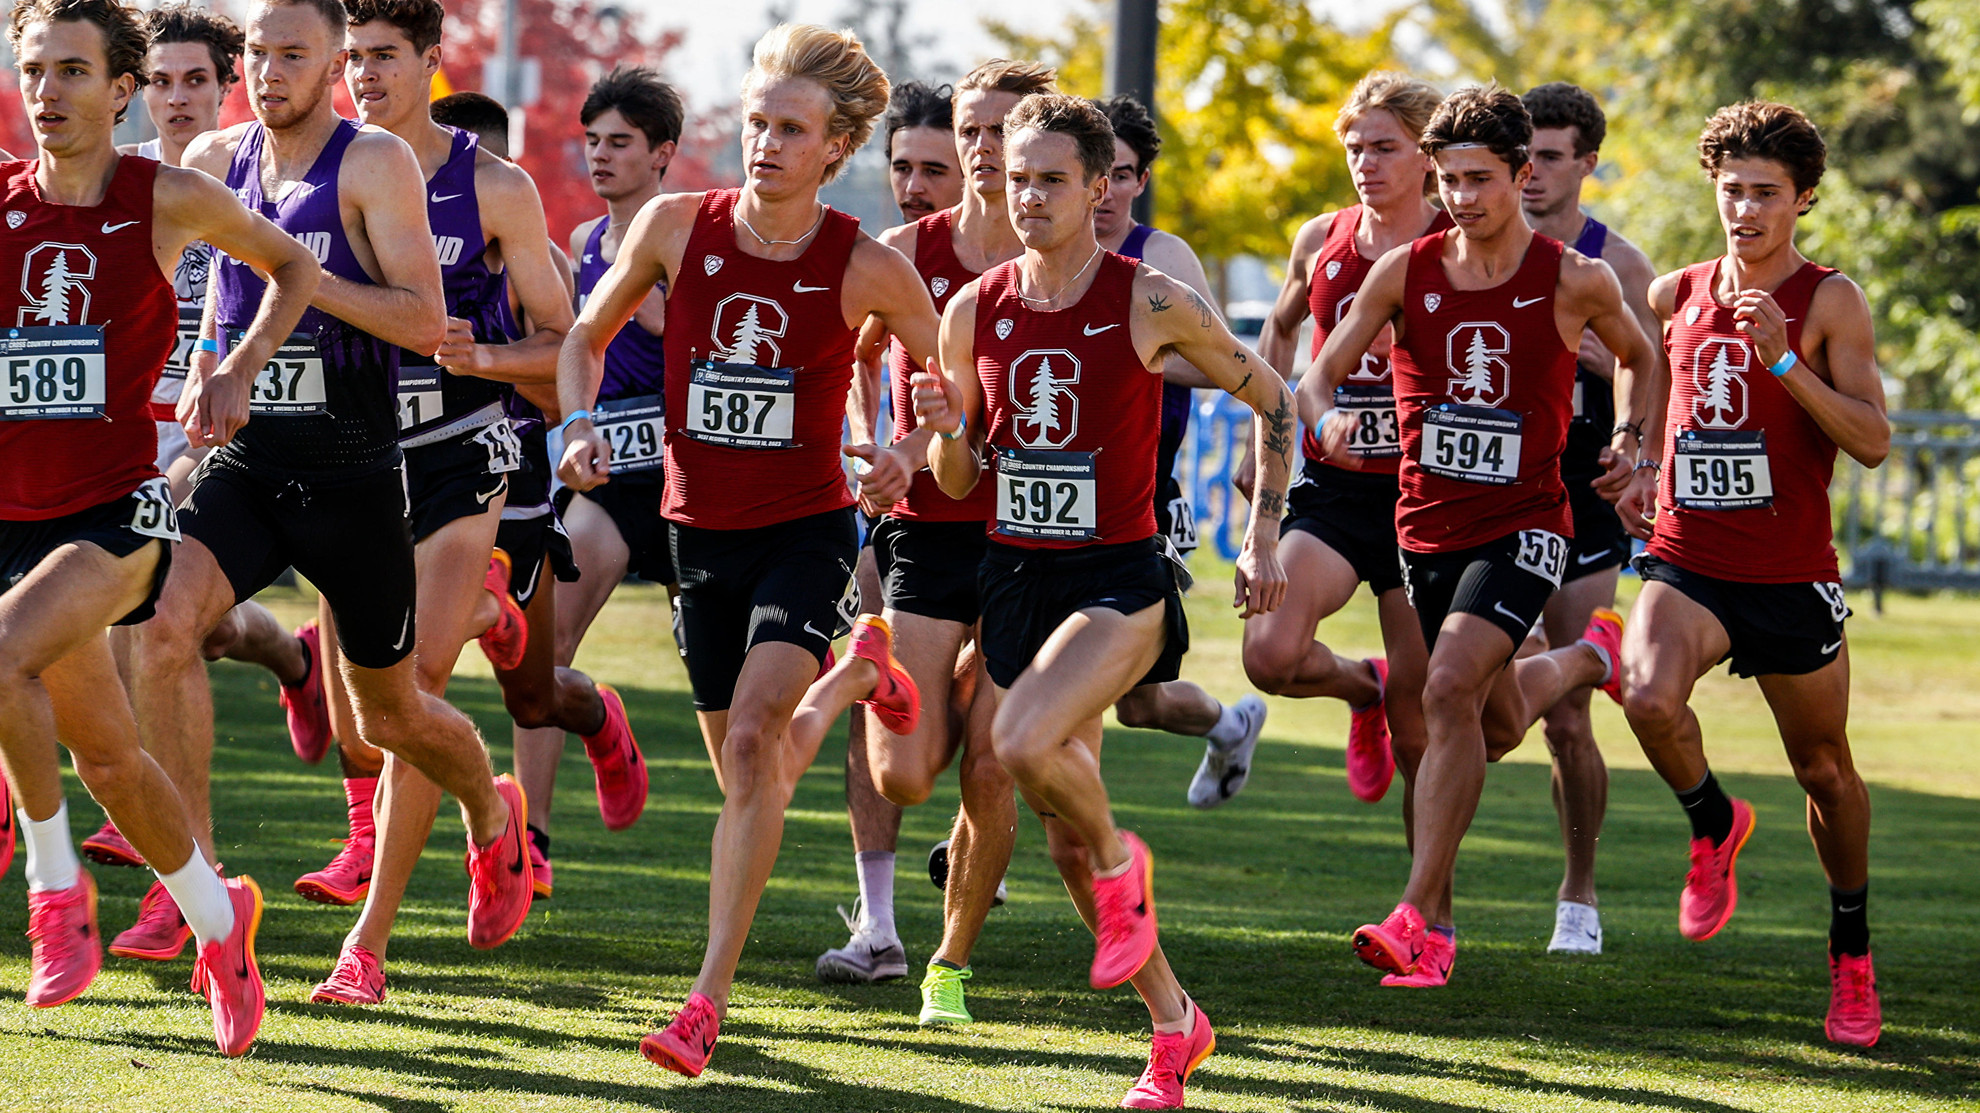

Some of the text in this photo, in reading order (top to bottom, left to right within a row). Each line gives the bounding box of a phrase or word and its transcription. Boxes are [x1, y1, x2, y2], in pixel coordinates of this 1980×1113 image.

[9, 357, 85, 403] 589
[398, 378, 436, 386] HAMPIONSHIPS
[745, 377, 789, 386] CHAMPIONSHIPS
[703, 390, 776, 434] 587
[1455, 416, 1477, 424] COUNTRY
[1477, 418, 1518, 428] CHAMPIONSHIPS
[1436, 429, 1504, 472] 594
[1690, 458, 1754, 496] 595
[1009, 479, 1079, 524] 592
[1524, 531, 1567, 577] 59
